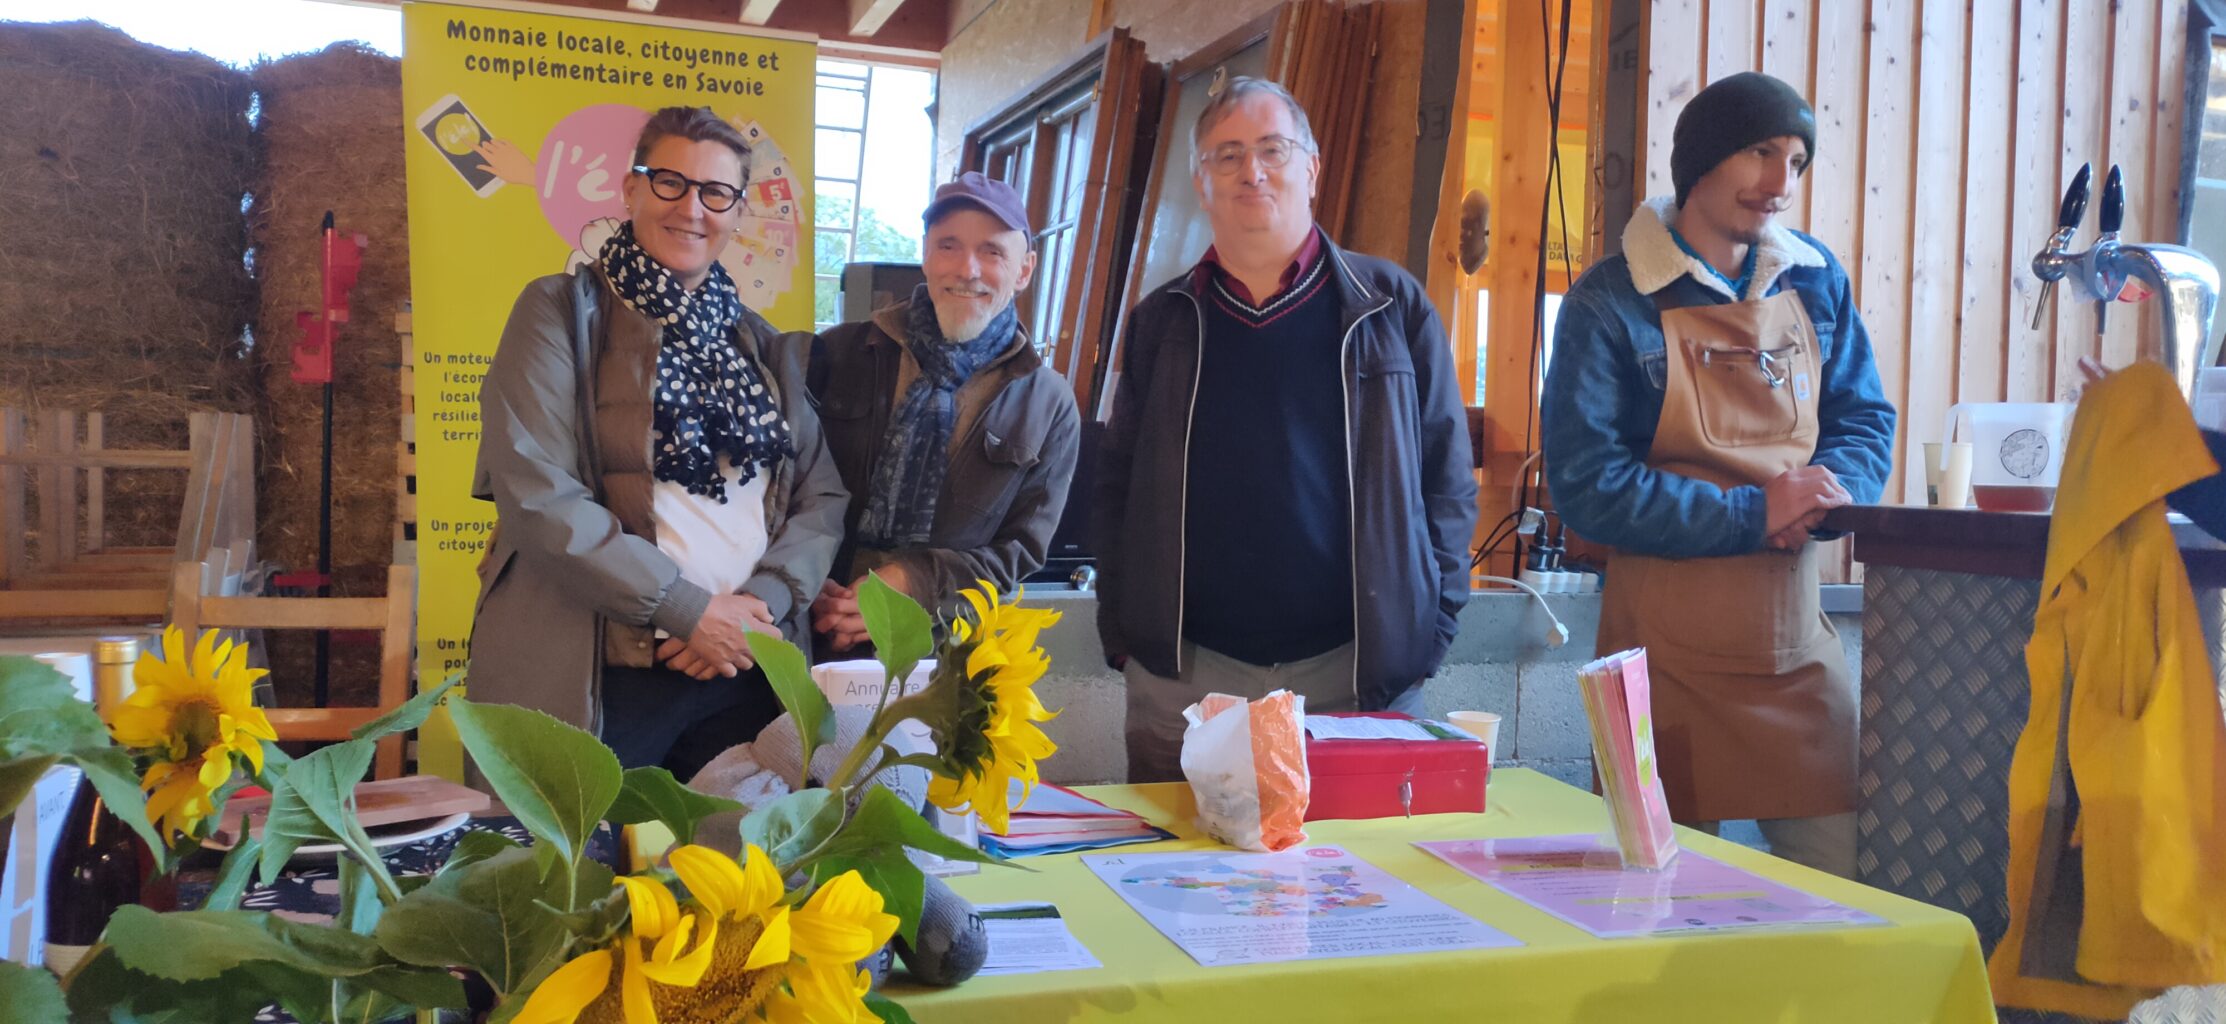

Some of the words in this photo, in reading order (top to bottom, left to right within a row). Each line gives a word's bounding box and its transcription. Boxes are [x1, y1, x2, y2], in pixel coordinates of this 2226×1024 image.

[447, 18, 548, 48] Monnaie
[557, 30, 632, 58] locale,
[641, 40, 749, 69] citoyenne
[757, 51, 779, 71] et
[464, 54, 654, 87] complémentaire
[663, 73, 687, 90] en
[696, 71, 764, 96] Savoie
[424, 352, 441, 364] Un
[443, 429, 482, 441] terri
[431, 519, 449, 531] Un
[455, 518, 497, 535] proje
[439, 538, 487, 554] citoye
[437, 638, 456, 650] Un
